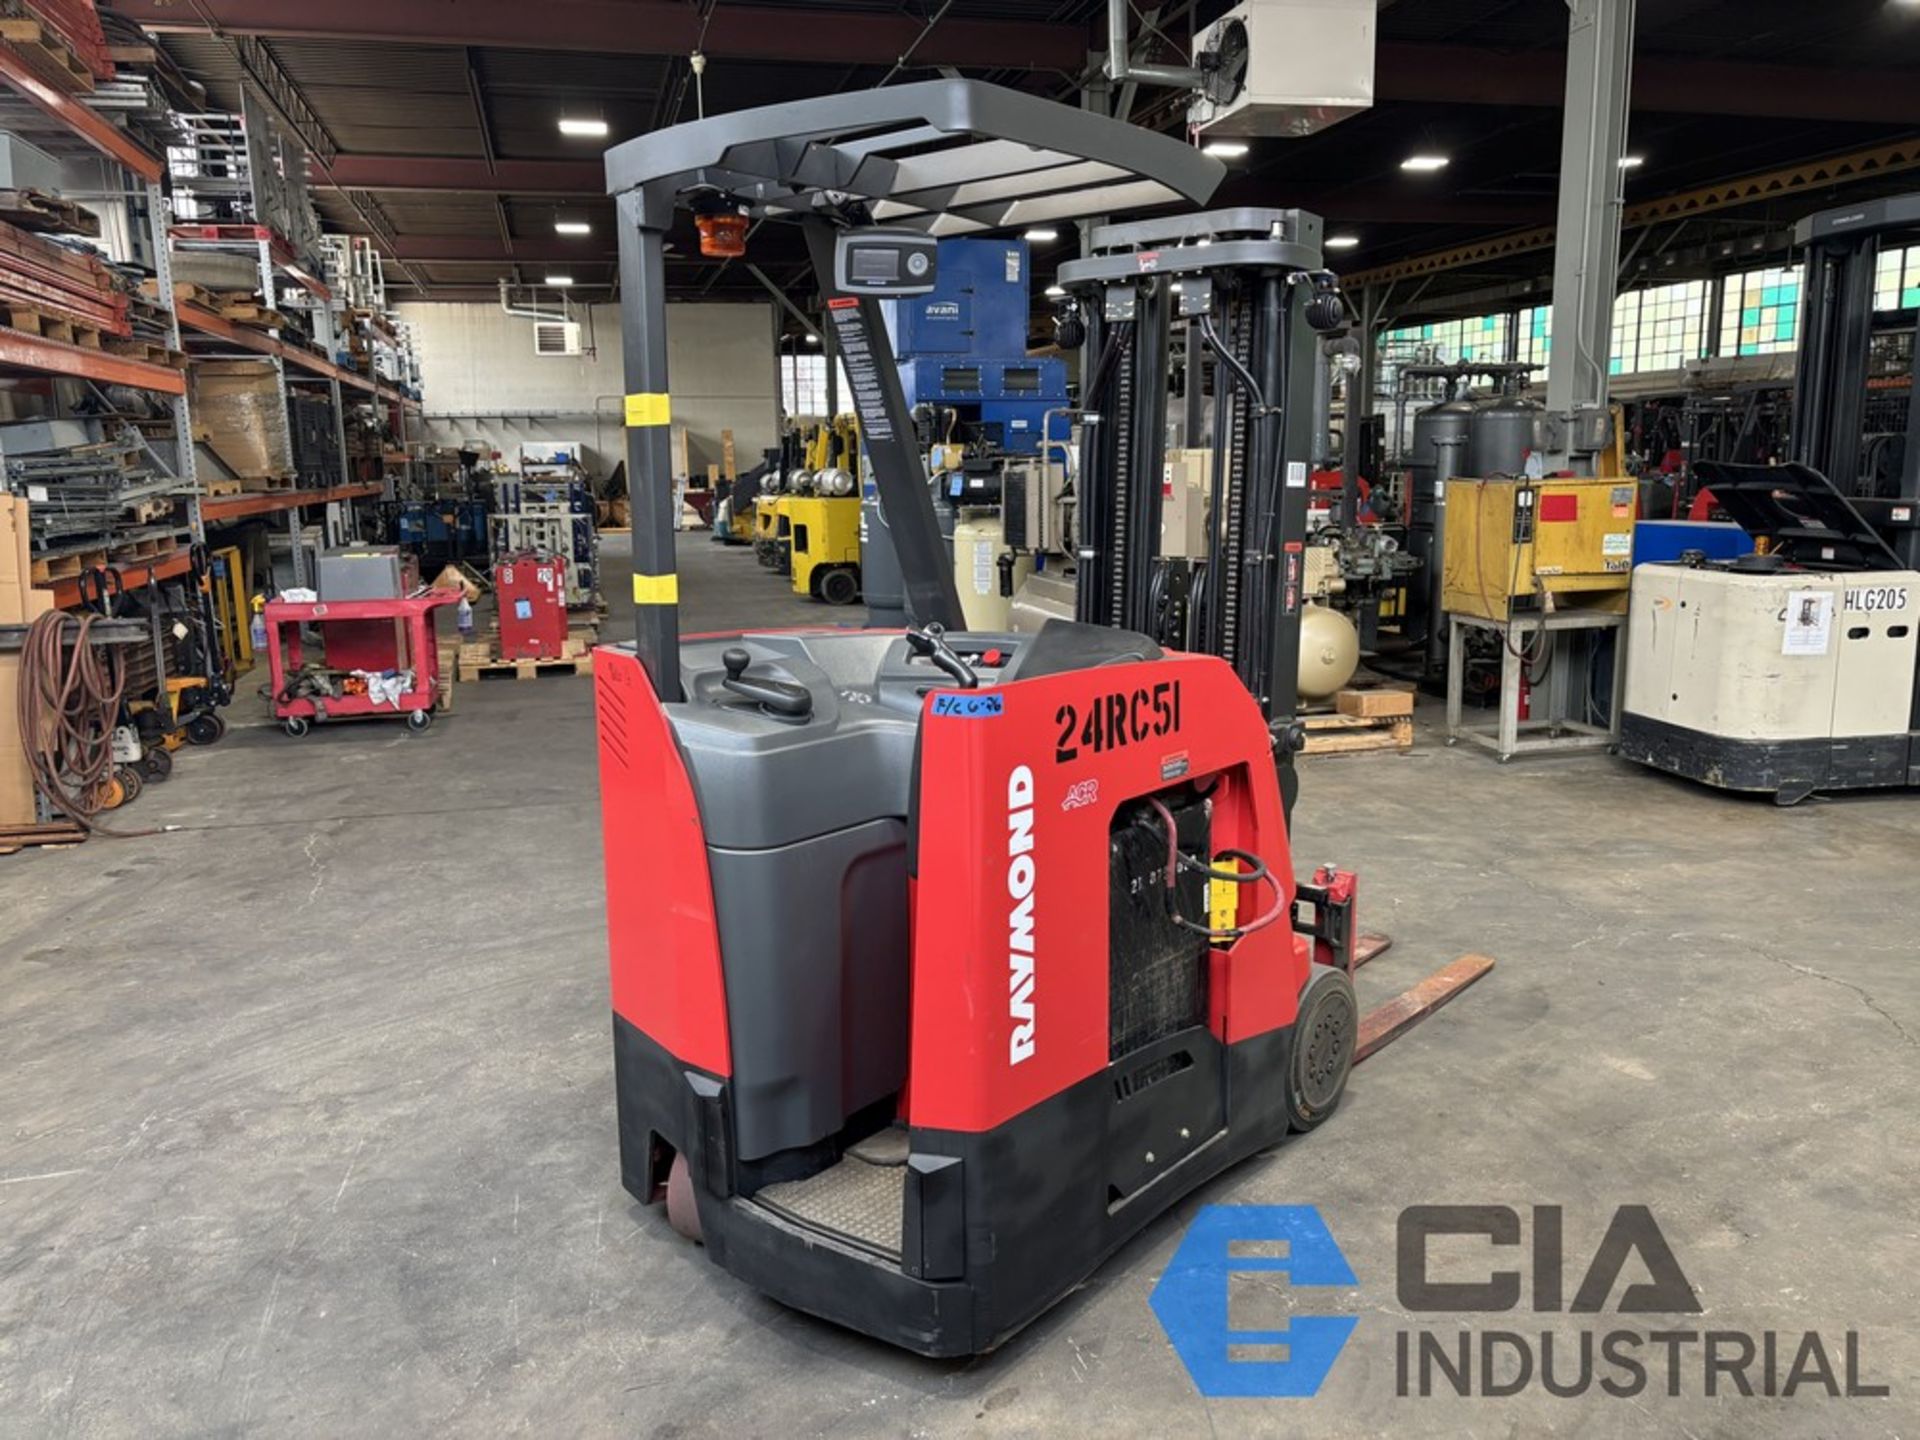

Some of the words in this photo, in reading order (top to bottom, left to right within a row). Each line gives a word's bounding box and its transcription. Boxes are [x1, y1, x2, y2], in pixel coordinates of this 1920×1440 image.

[925, 303, 959, 315] avani
[1844, 589, 1907, 610] HLG205
[1007, 765, 1036, 1067] RAYMOND
